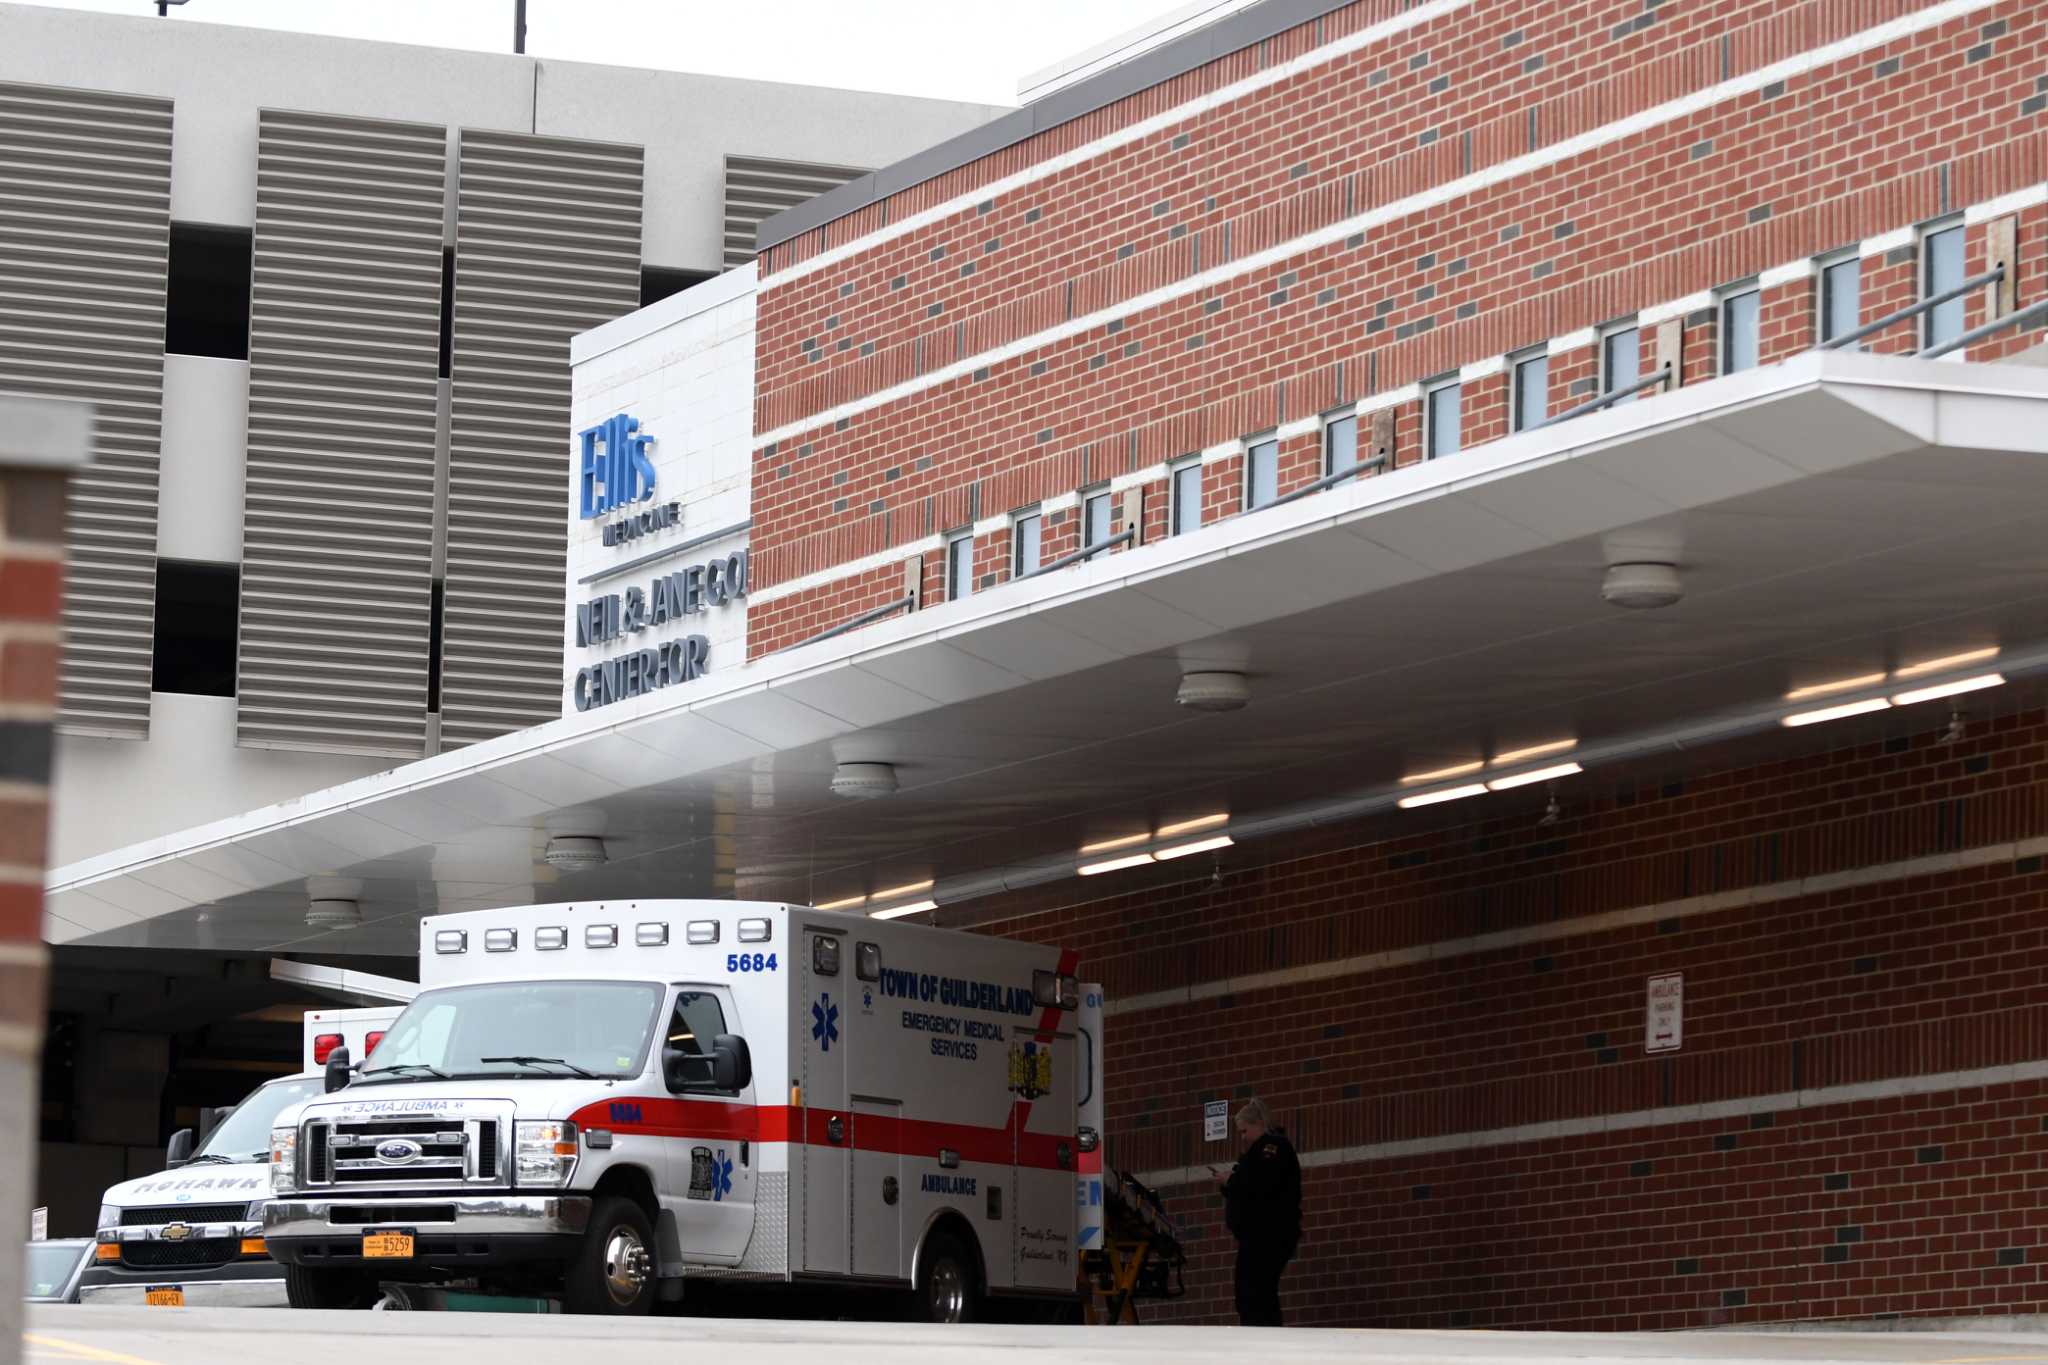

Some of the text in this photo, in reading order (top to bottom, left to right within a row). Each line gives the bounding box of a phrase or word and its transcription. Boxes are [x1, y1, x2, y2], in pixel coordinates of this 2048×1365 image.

[578, 413, 656, 520] Ellis
[602, 502, 681, 547] MEDICINE
[576, 548, 749, 648] NEIL & JANE GO
[574, 634, 709, 712] CENTER FOR
[727, 953, 778, 973] 5684
[879, 968, 1034, 1017] TOWN OF GUILDERLAND
[902, 1010, 1004, 1042] EMERGENCY MEDICAL
[931, 1038, 977, 1061] SERVICES
[134, 1177, 264, 1194] MOHAWK
[921, 1174, 977, 1196] AMBULANCE
[389, 1237, 410, 1252] 5259
